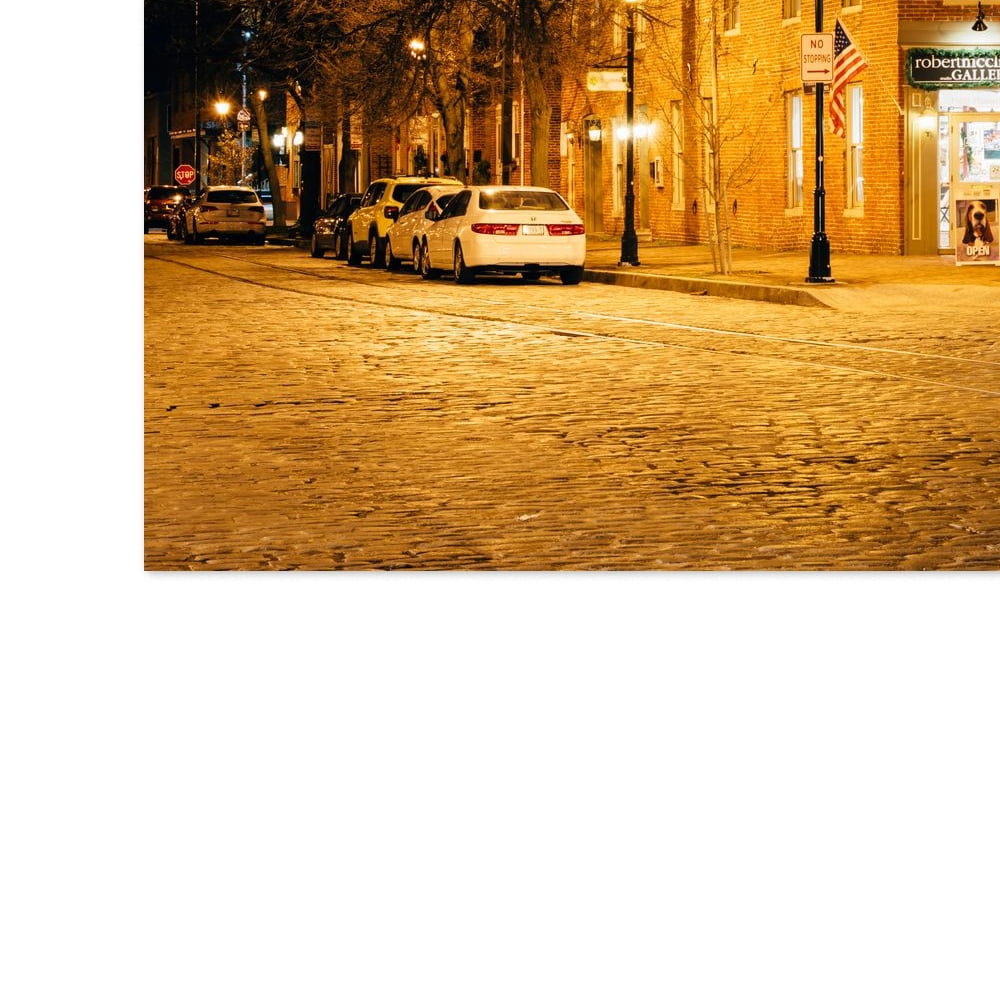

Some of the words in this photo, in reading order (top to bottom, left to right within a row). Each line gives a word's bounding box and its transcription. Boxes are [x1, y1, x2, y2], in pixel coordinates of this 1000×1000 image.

[810, 40, 823, 49] NO
[803, 54, 831, 63] STOPPING
[176, 170, 194, 179] STOP
[966, 246, 990, 256] OPEN
